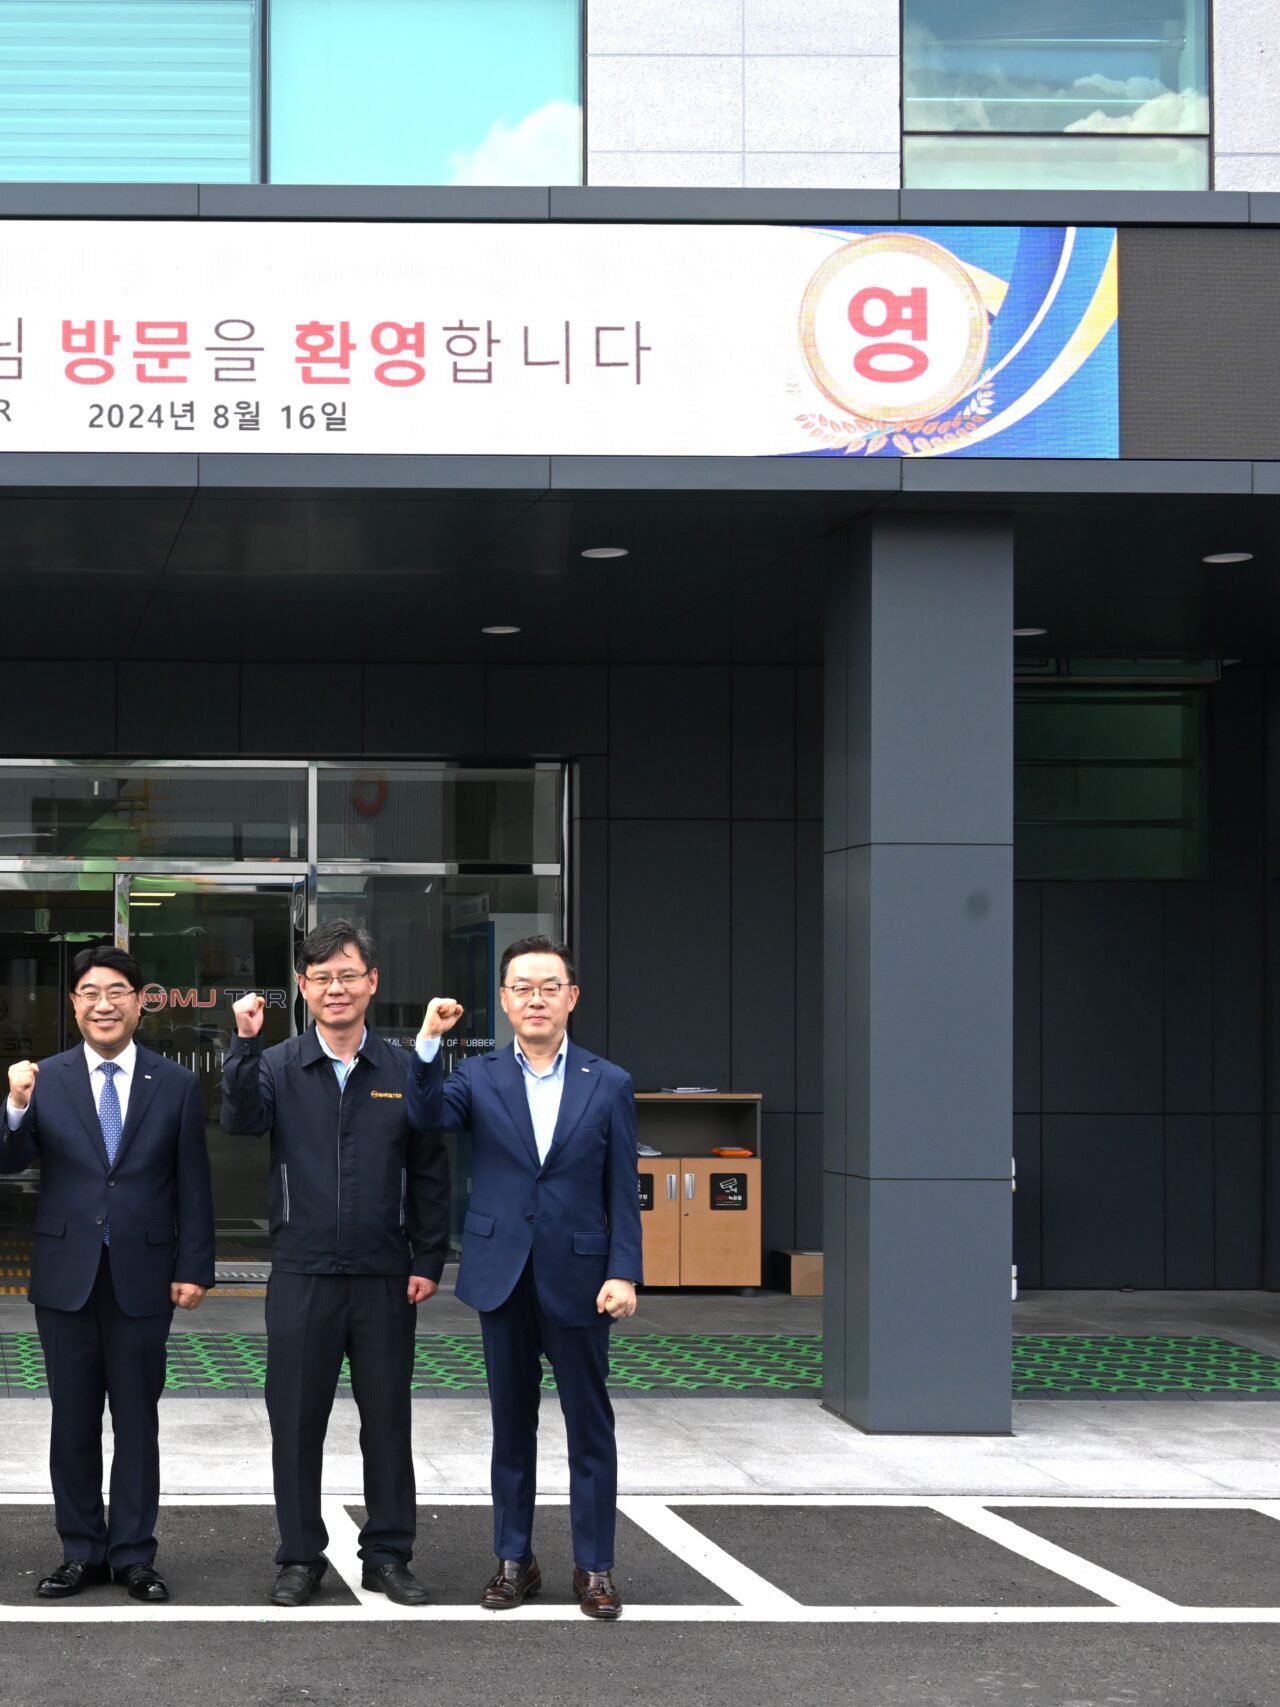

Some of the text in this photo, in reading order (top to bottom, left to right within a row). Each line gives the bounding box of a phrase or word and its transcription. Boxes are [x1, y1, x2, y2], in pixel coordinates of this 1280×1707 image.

[847, 286, 929, 383] 영
[61, 319, 265, 385] 방문을
[294, 319, 652, 388] 환영합니다
[88, 400, 195, 431] 2024년
[213, 400, 261, 431] 8월
[280, 401, 347, 432] 16일
[169, 988, 287, 1009] MJ TR
[446, 1038, 459, 1047] OF
